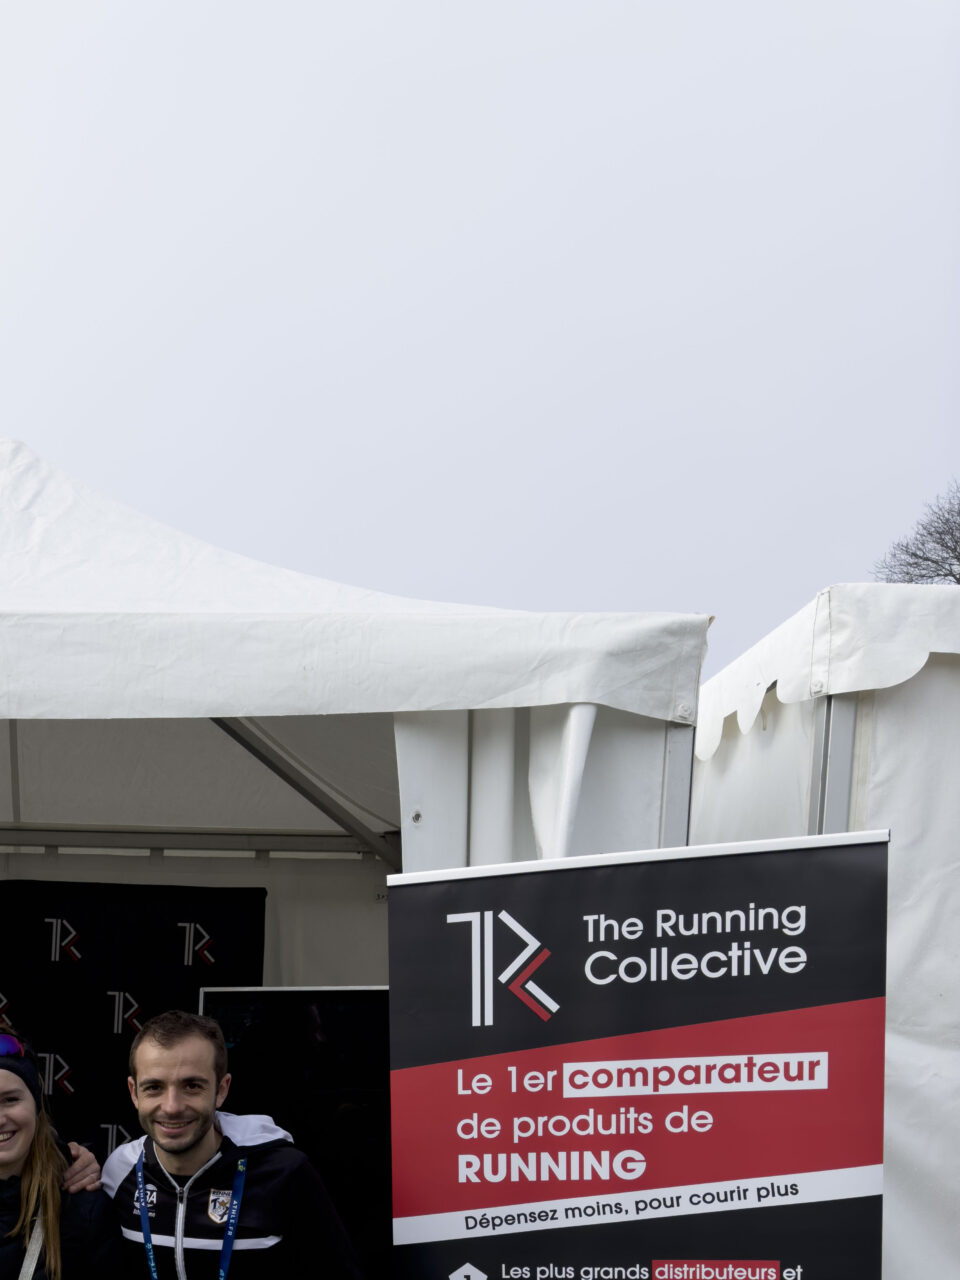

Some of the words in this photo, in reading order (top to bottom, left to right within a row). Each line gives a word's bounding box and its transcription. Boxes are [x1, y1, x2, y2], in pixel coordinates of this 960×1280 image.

[584, 913, 644, 943] The
[656, 903, 807, 938] Running
[584, 942, 808, 986] Collective
[457, 1069, 493, 1095] Le
[508, 1065, 558, 1093] 1er
[568, 1056, 821, 1092] comparateur
[456, 1113, 501, 1140] de
[513, 1106, 653, 1144] produits
[664, 1105, 714, 1133] de
[458, 1149, 647, 1183] RUNNING
[465, 1207, 559, 1232] Dépensez
[564, 1200, 629, 1219] moins,
[635, 1193, 682, 1214] pour
[689, 1186, 749, 1207] courir
[756, 1181, 799, 1203] plus
[501, 1264, 531, 1280] Les
[783, 1266, 803, 1280] et
